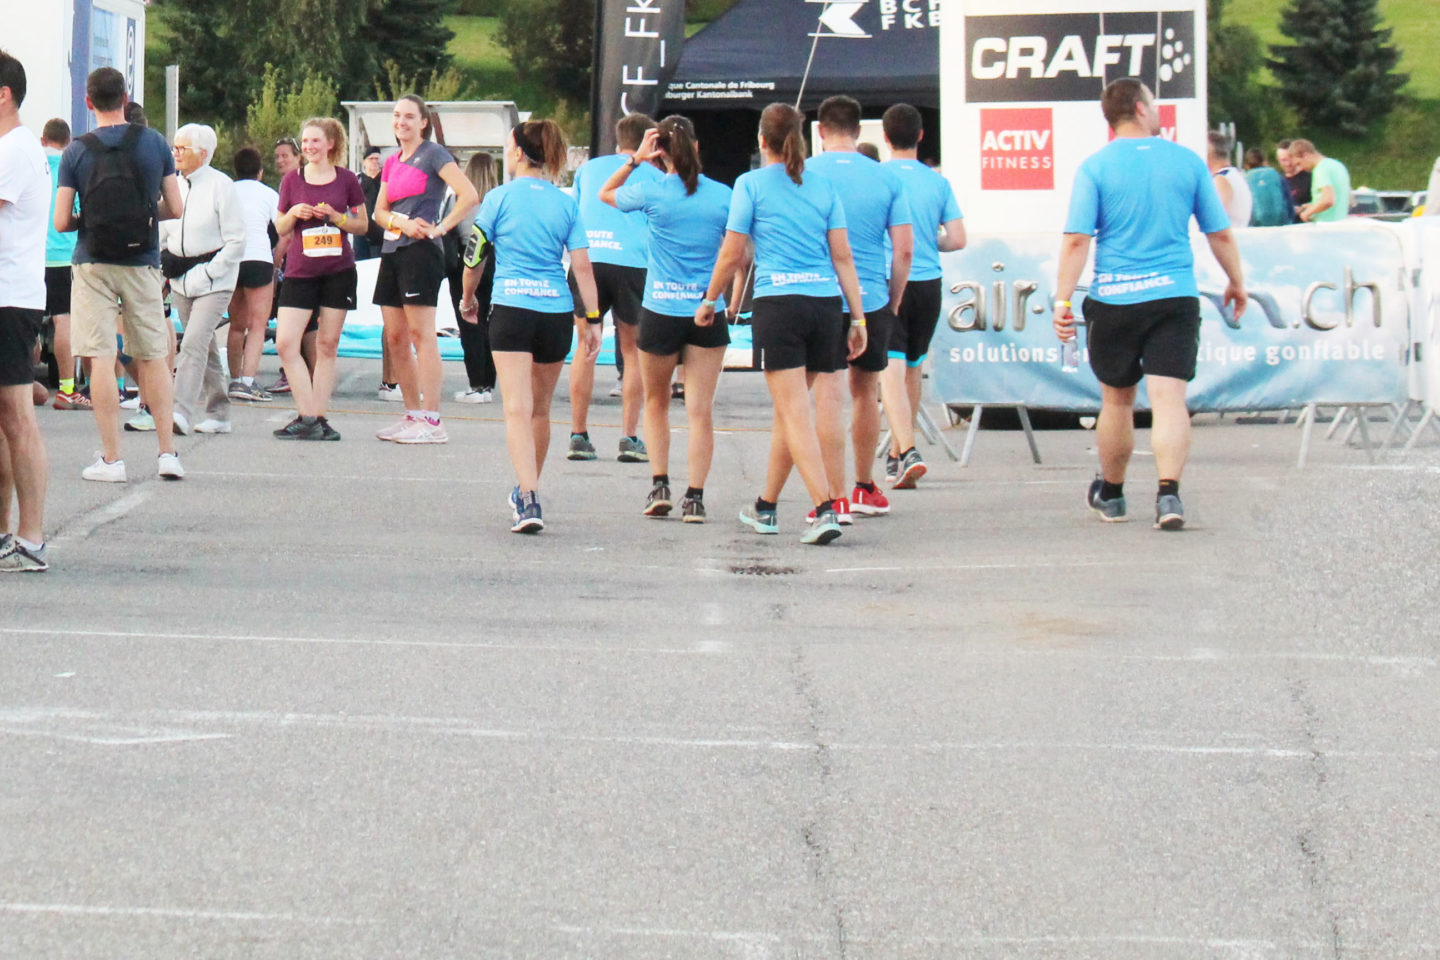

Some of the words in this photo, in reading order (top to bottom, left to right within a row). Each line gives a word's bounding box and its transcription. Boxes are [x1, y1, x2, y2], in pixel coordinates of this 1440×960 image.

[971, 34, 1156, 79] CRAFT
[685, 81, 727, 90] Cantonale
[727, 81, 739, 89] de
[739, 81, 776, 91] Fribourg
[696, 90, 754, 98] Kantonalbank
[982, 129, 1051, 151] ACTIV
[982, 155, 1052, 170] FITNESS
[314, 235, 333, 246] 249
[949, 340, 1058, 363] solutions
[1265, 338, 1385, 366] gonflable
